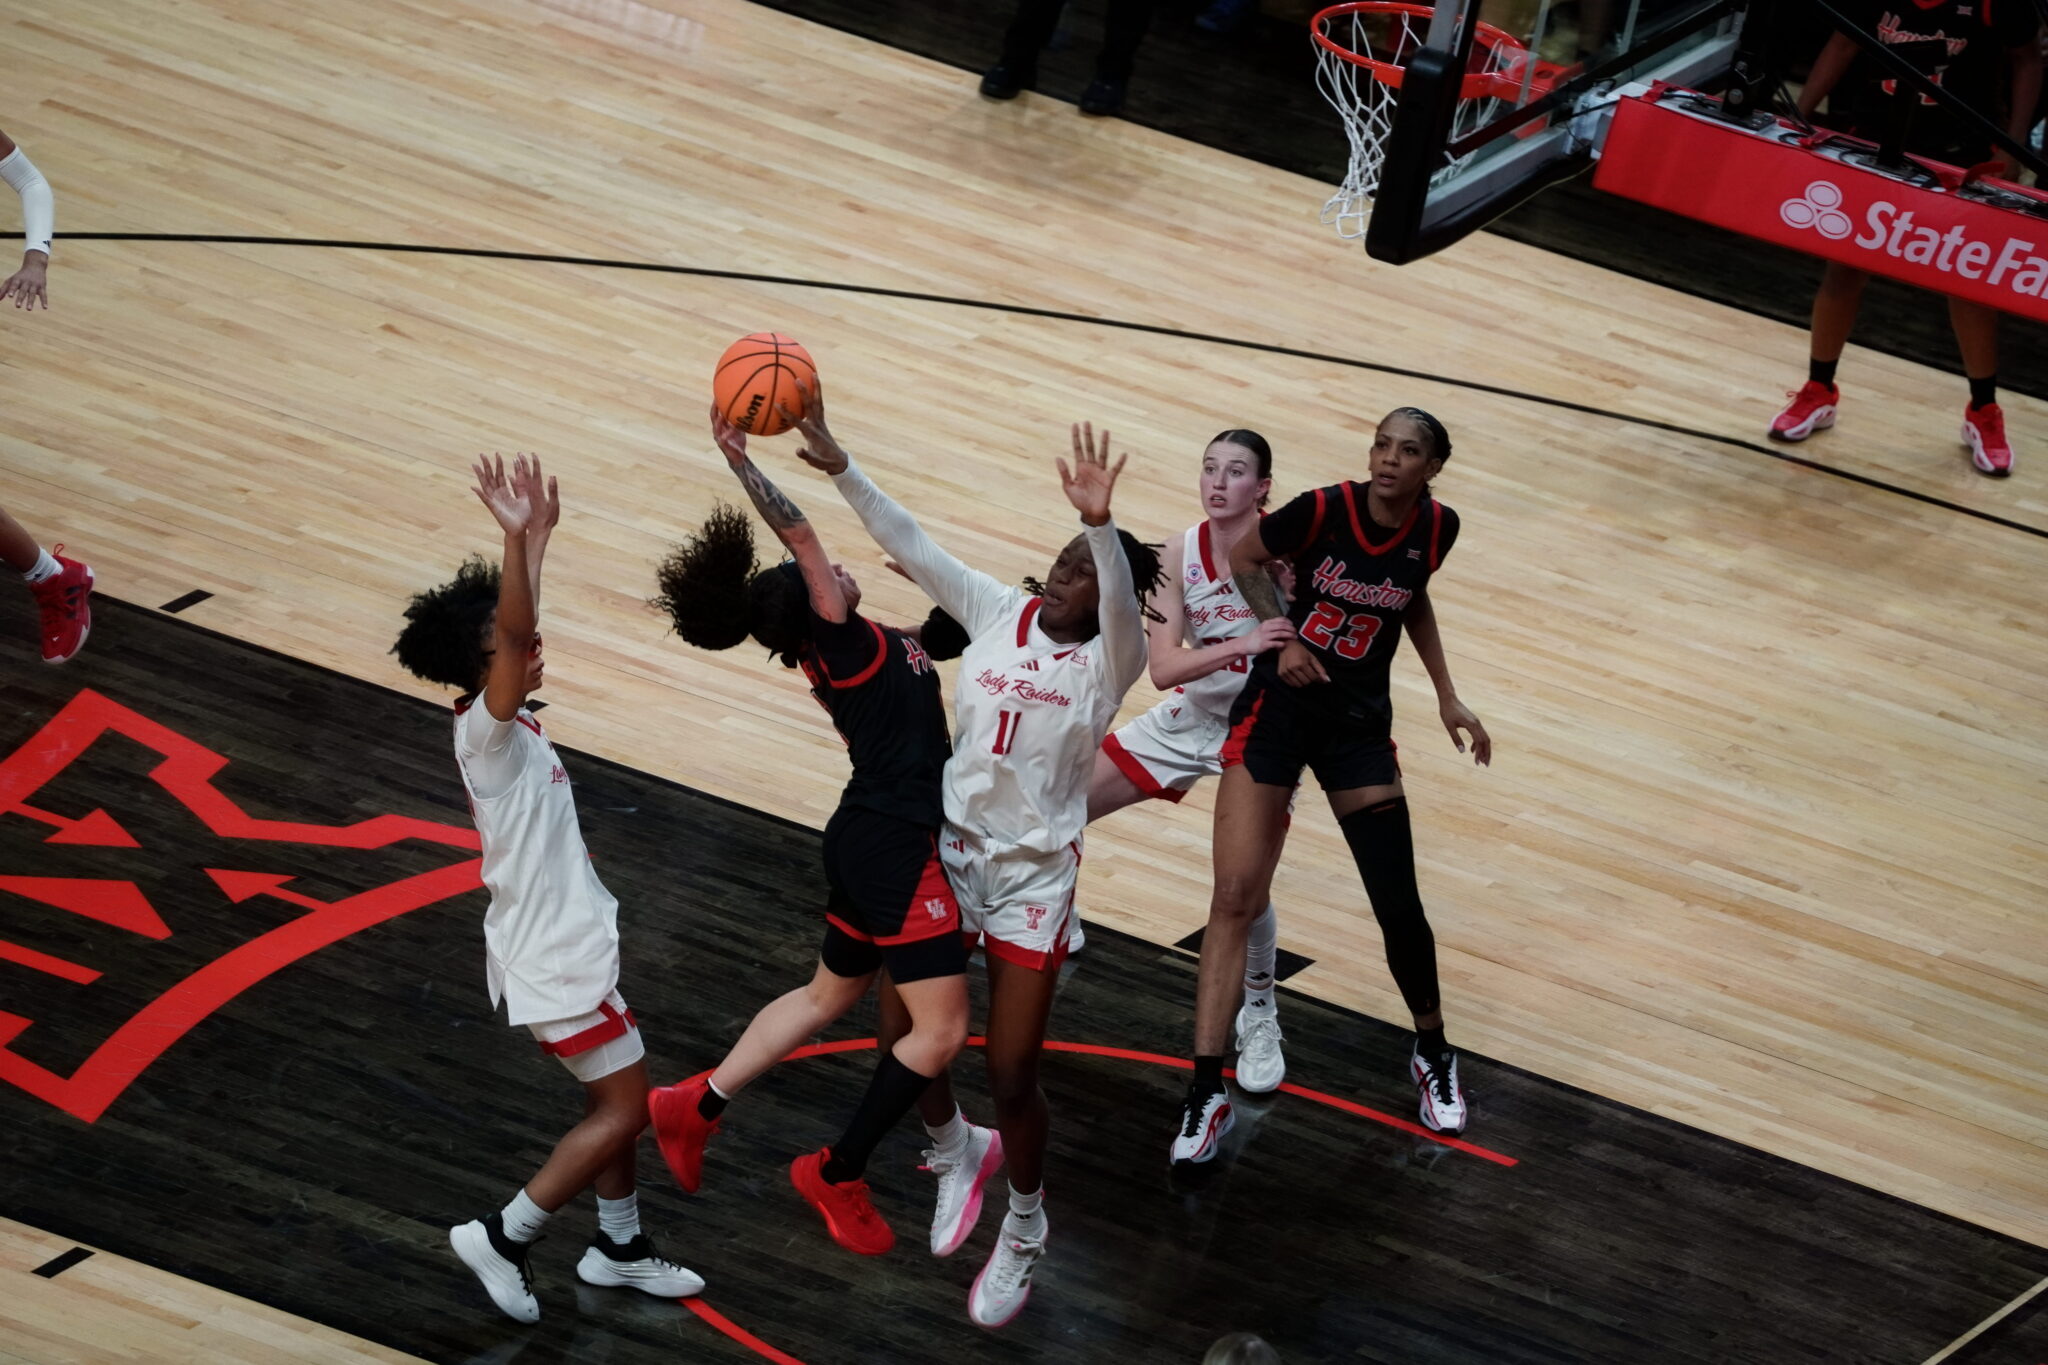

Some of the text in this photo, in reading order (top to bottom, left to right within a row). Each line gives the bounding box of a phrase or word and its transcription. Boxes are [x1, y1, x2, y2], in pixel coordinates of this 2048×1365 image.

[1312, 555, 1413, 610] Houston
[1214, 604, 1256, 622] Raide
[1299, 601, 1383, 660] 23
[975, 668, 1072, 707] Lady Raiders
[992, 710, 1022, 756] 11
